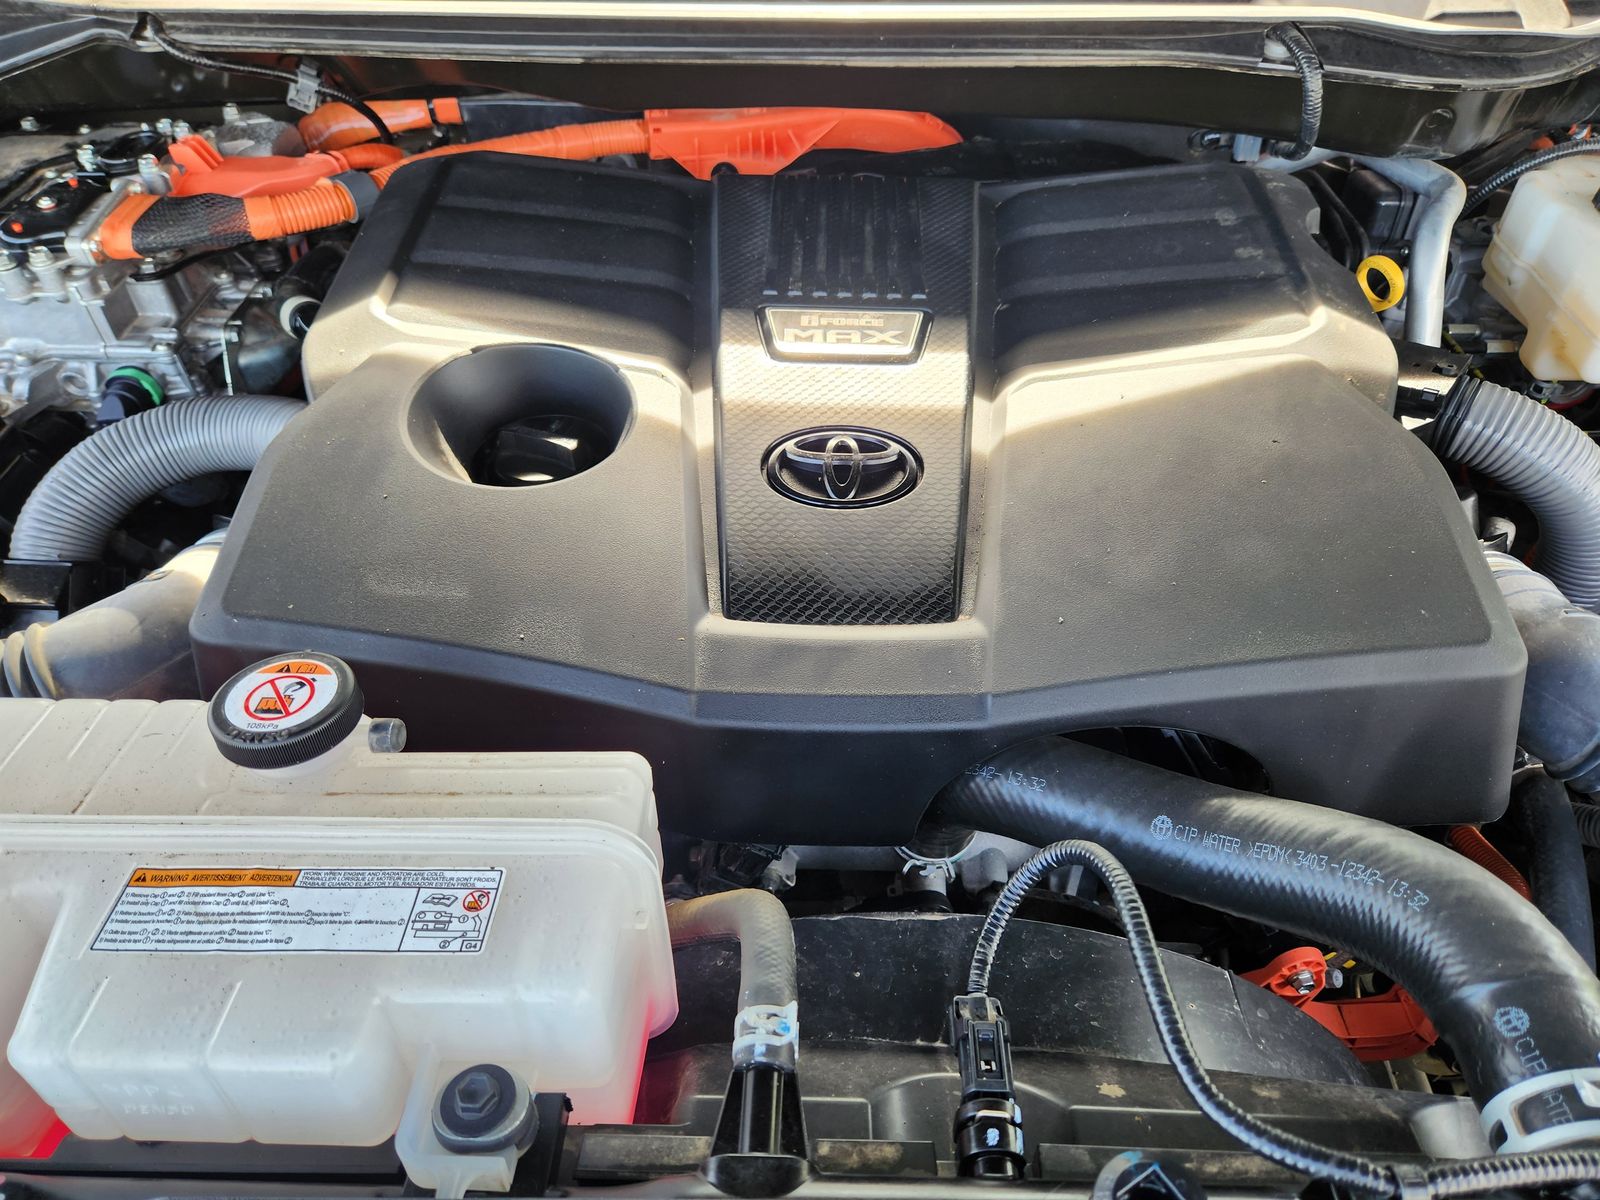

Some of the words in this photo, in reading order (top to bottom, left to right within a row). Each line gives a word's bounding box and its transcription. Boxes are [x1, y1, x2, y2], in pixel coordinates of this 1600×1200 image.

[784, 328, 904, 344] MAX
[1174, 824, 1198, 842] CIP
[1202, 830, 1240, 854] WATER
[1515, 1036, 1548, 1072] CIP
